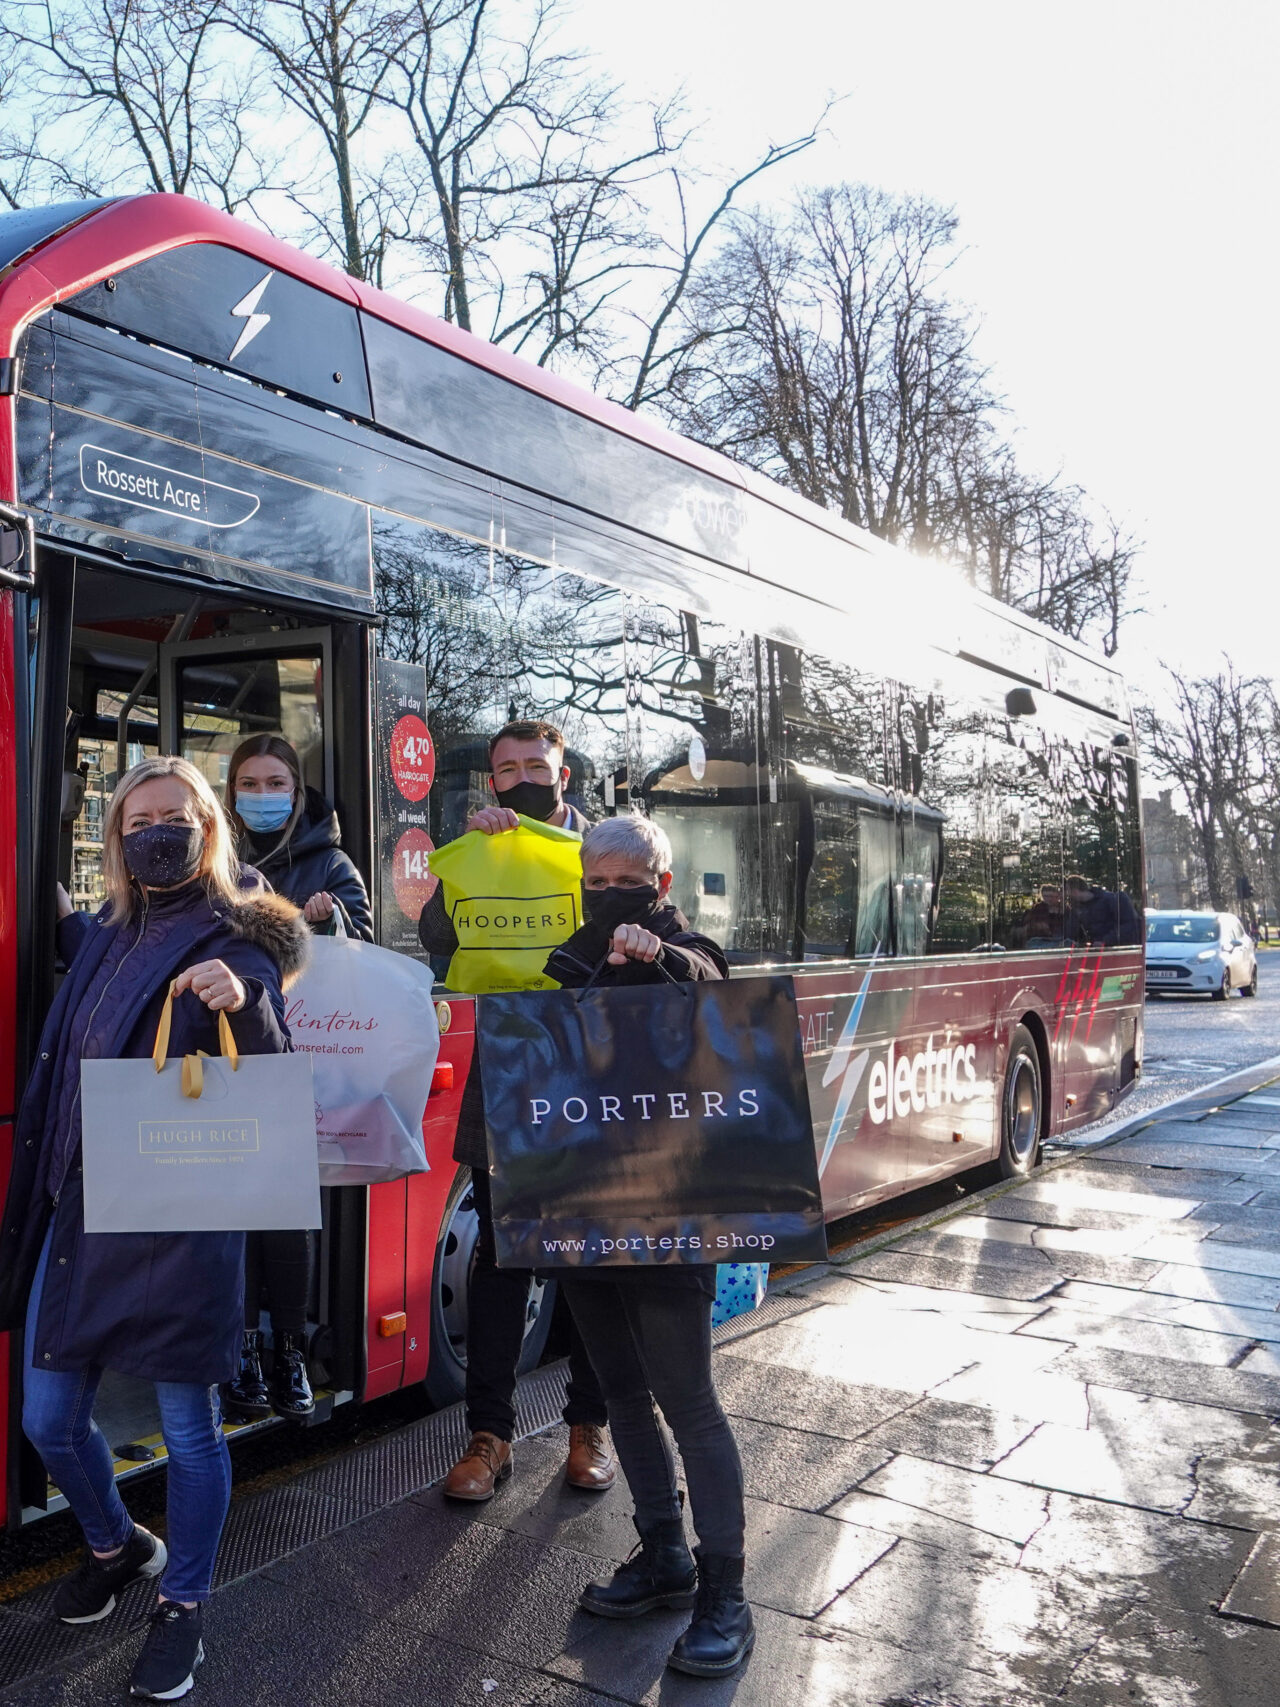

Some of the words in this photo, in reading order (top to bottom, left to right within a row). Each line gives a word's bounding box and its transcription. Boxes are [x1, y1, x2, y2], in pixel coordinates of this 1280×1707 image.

[97, 459, 160, 500] Rossett
[163, 480, 201, 511] Acre
[398, 694, 407, 708] all
[407, 695, 421, 712] day
[398, 809, 407, 823] all
[407, 811, 427, 825] week
[402, 849, 433, 880] 14.5
[458, 912, 567, 929] HOOPERS
[283, 995, 379, 1032] lintons
[798, 1011, 834, 1052] ATE
[868, 1032, 978, 1125] electrics
[530, 1088, 760, 1125] PORTERS
[149, 1130, 201, 1144] HUGH
[209, 1128, 248, 1142] RICE
[542, 1232, 776, 1256] www.porters.shop
